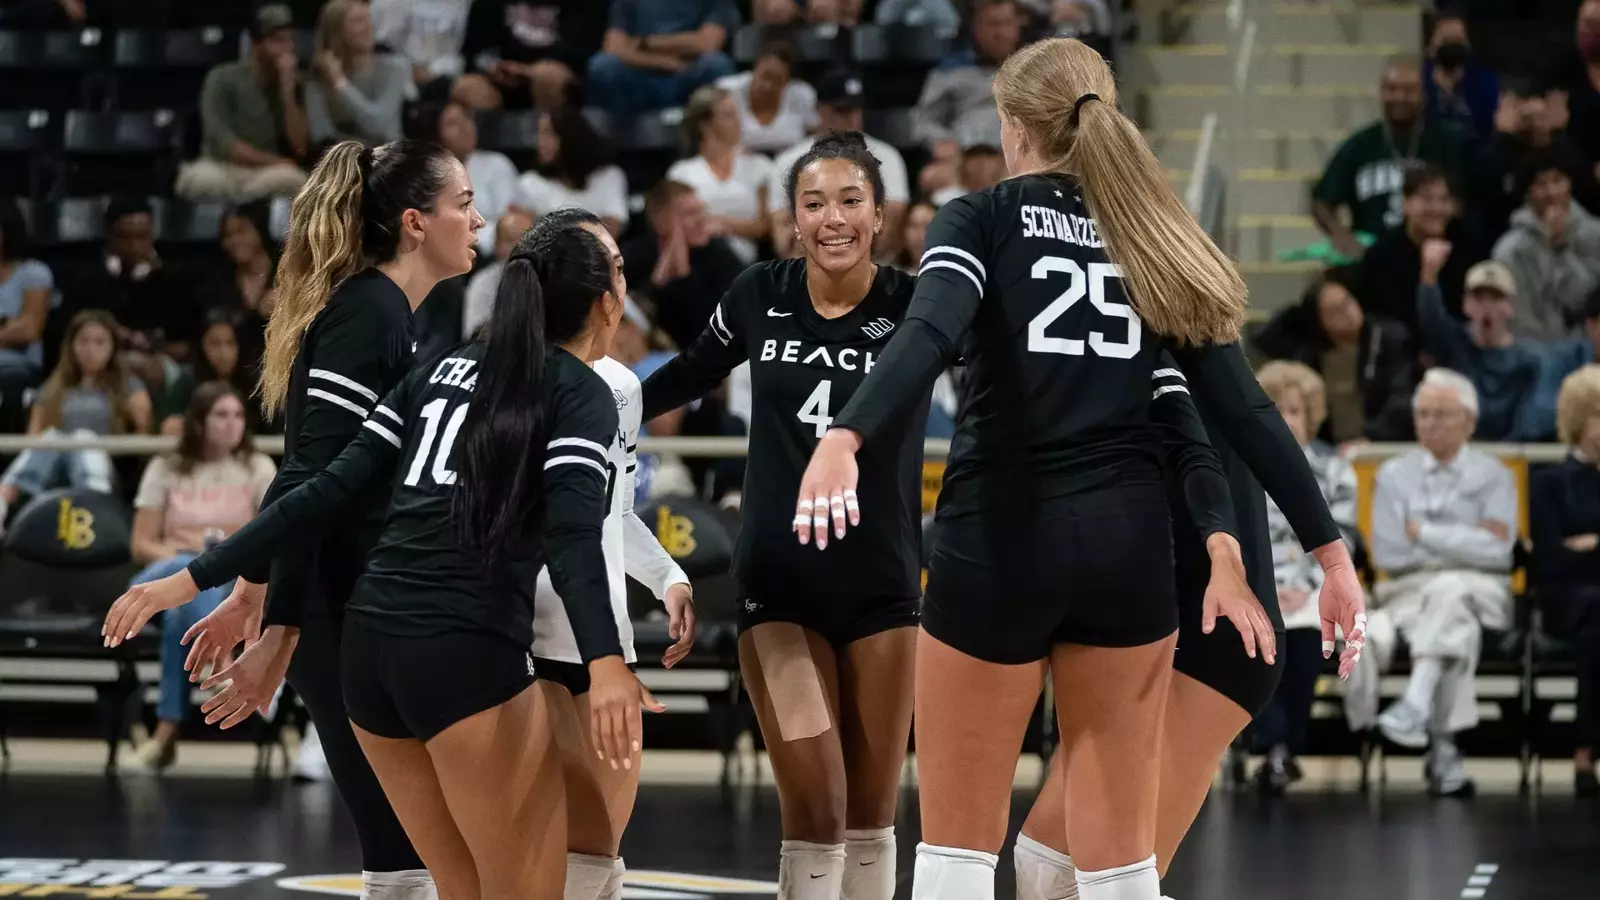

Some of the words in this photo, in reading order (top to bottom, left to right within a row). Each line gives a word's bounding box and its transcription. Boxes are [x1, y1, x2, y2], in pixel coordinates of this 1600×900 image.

[1021, 204, 1106, 248] SCHWARZE
[1028, 255, 1141, 359] 25
[429, 357, 479, 392] CHA
[760, 339, 881, 374] BEACH
[796, 379, 834, 438] 4
